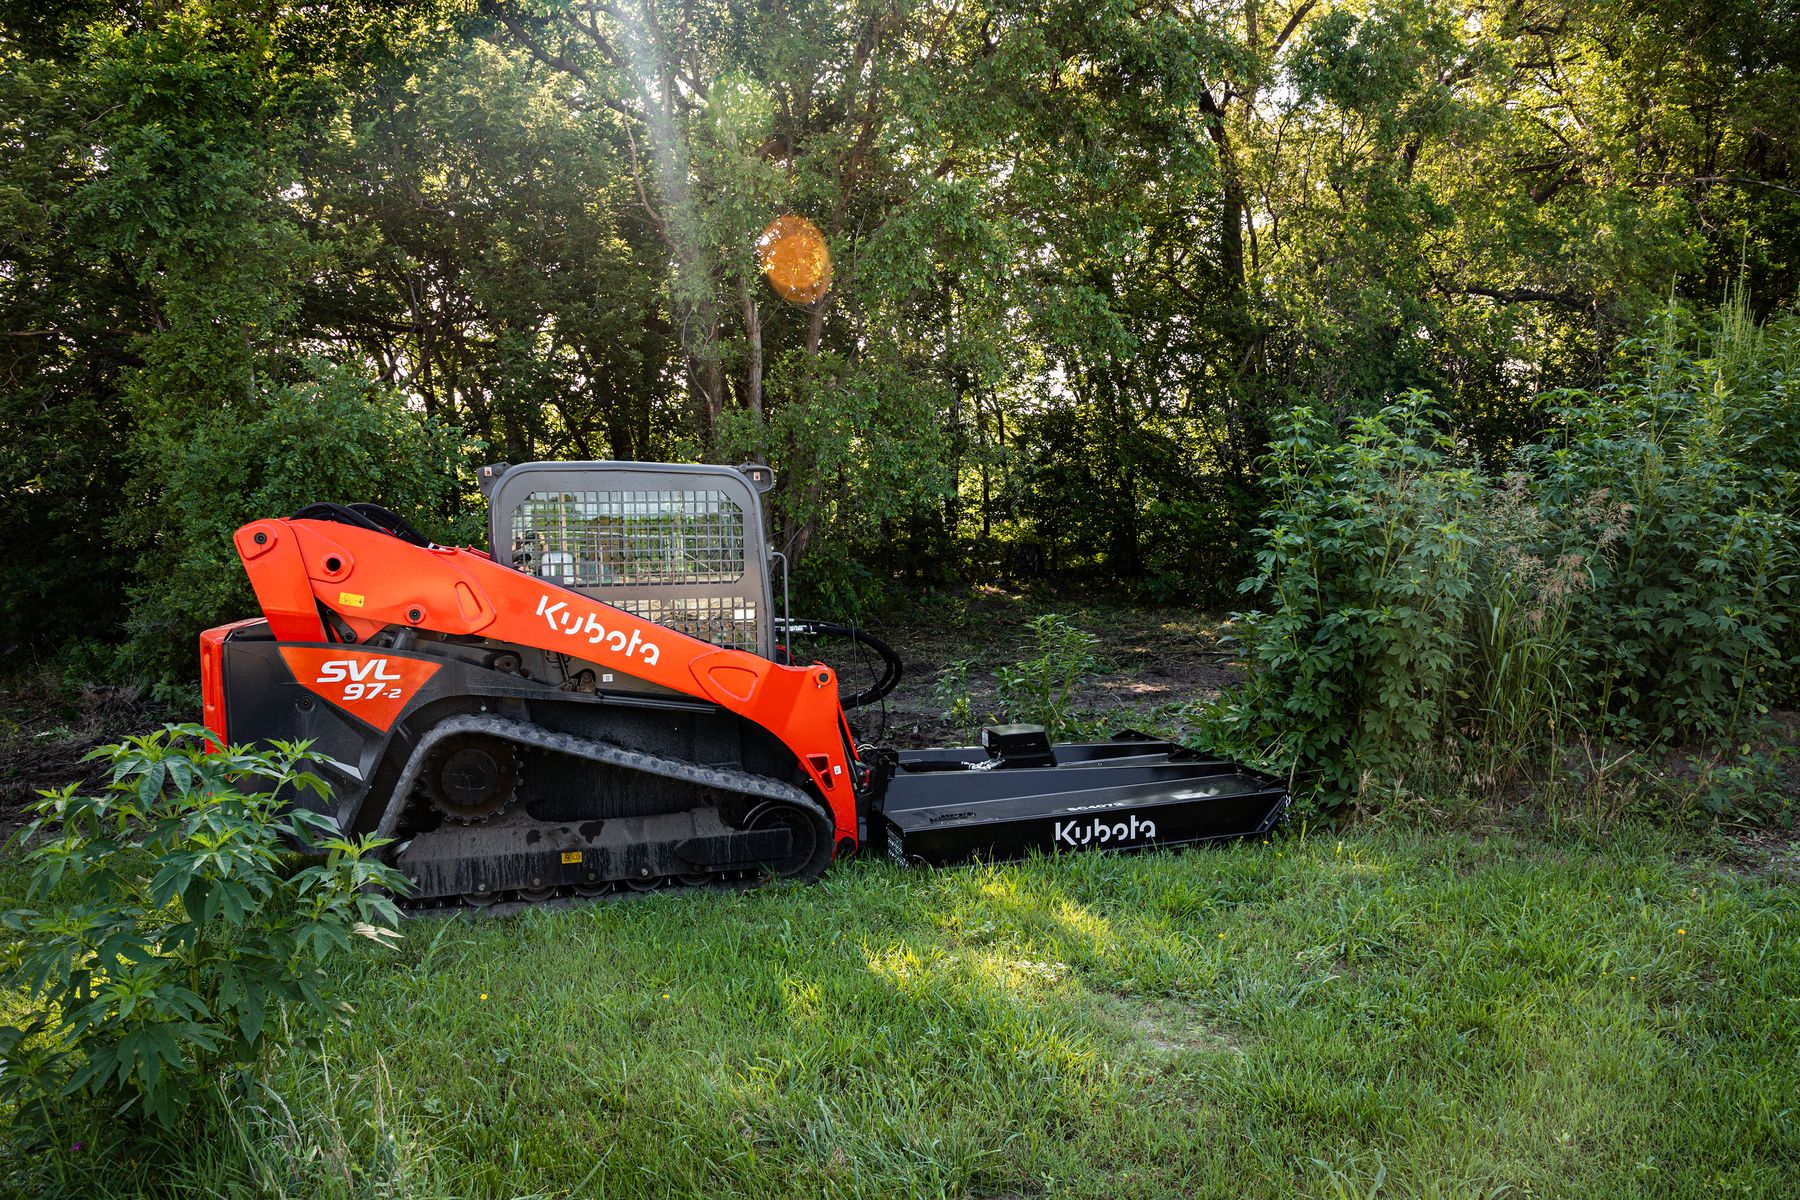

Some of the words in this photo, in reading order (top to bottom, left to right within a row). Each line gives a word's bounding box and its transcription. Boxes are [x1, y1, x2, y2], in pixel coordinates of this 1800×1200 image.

[536, 594, 660, 666] Kubota
[316, 659, 401, 683] SVL
[342, 683, 402, 701] 97-2
[1055, 815, 1156, 846] Kubota
